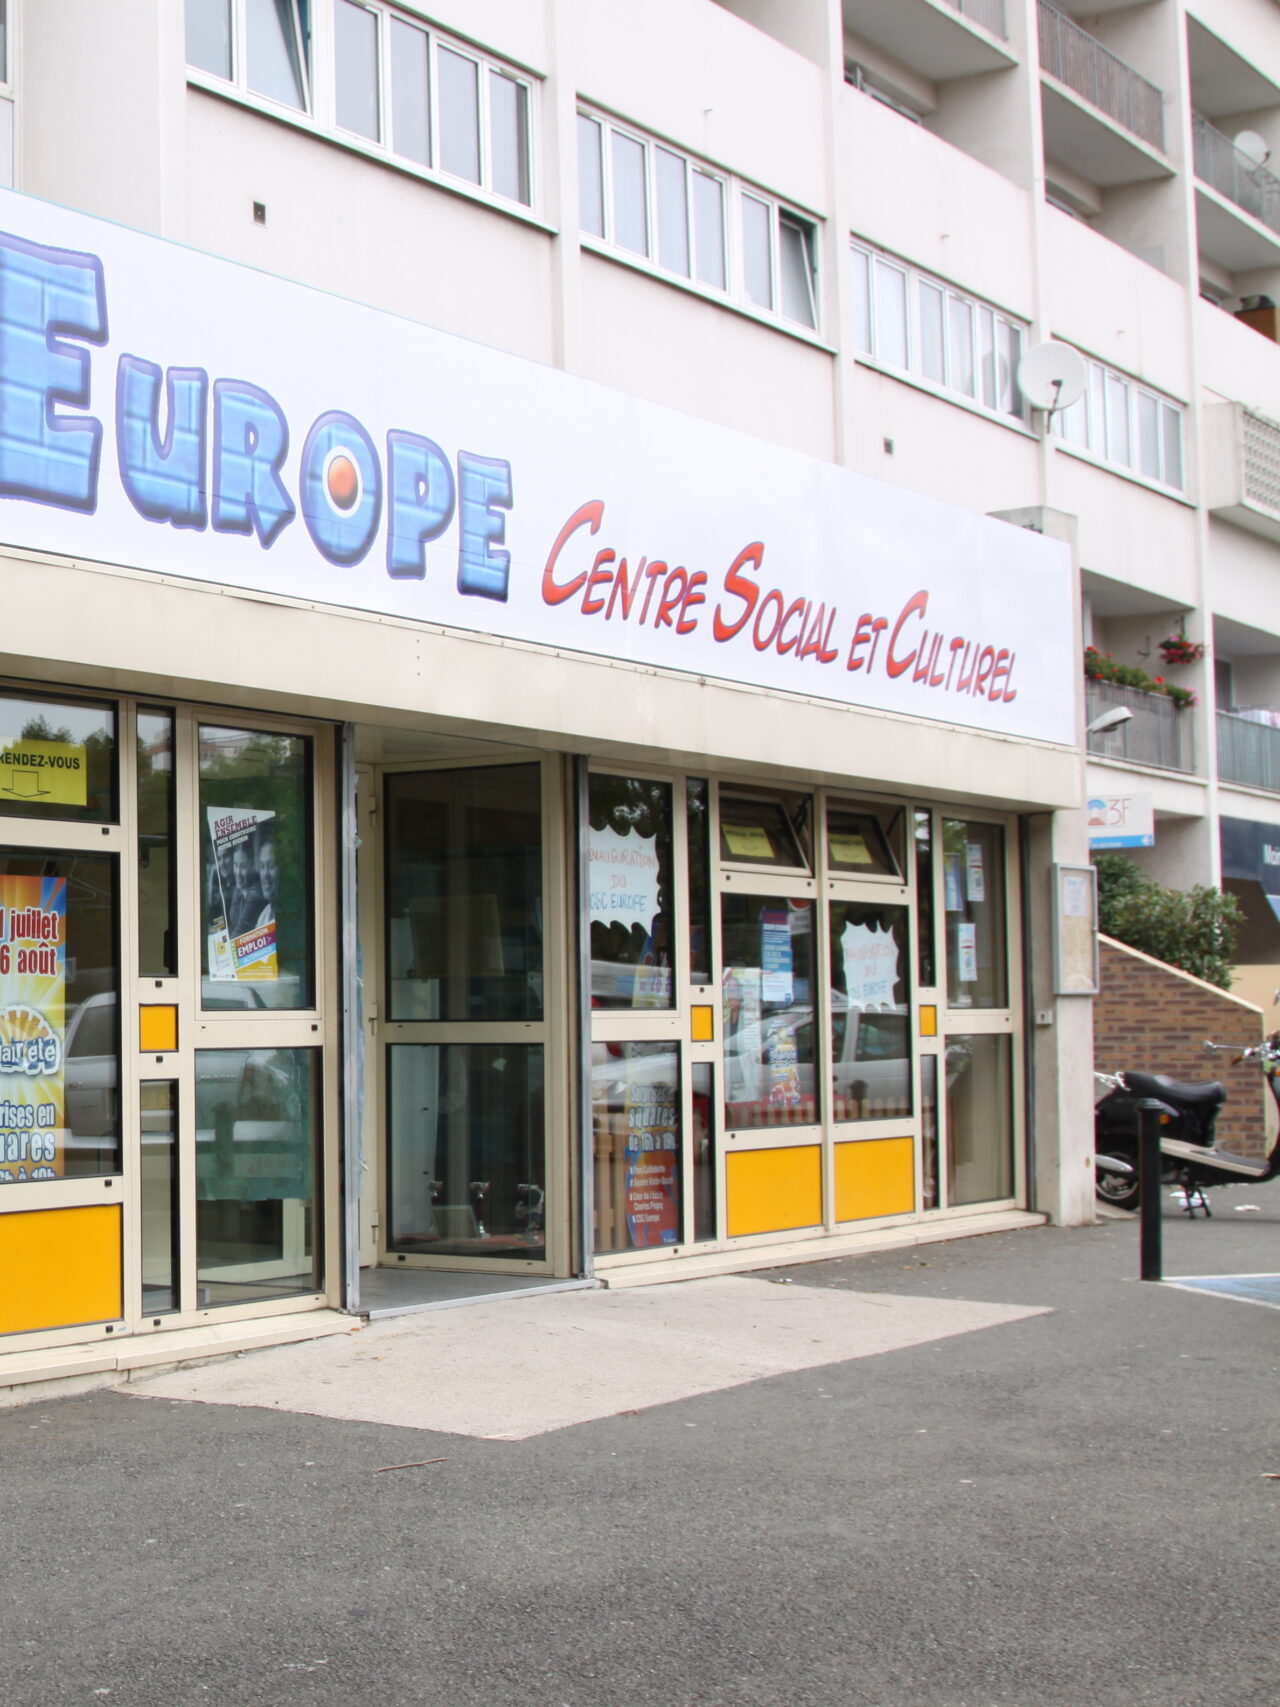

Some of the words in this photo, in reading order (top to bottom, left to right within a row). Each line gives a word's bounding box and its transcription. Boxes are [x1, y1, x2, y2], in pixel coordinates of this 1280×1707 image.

[541, 499, 708, 635] CENTRE
[713, 541, 838, 664] SOCIAL
[847, 613, 888, 674] ET
[886, 589, 1017, 703] CULTUREL
[214, 815, 233, 830] AGIR
[216, 815, 257, 840] ENSEMBLE
[9, 908, 58, 942] juillet
[17, 941, 56, 975] août
[237, 937, 267, 957] EMPLOI
[37, 1103, 56, 1128] en
[628, 1106, 676, 1129] squares
